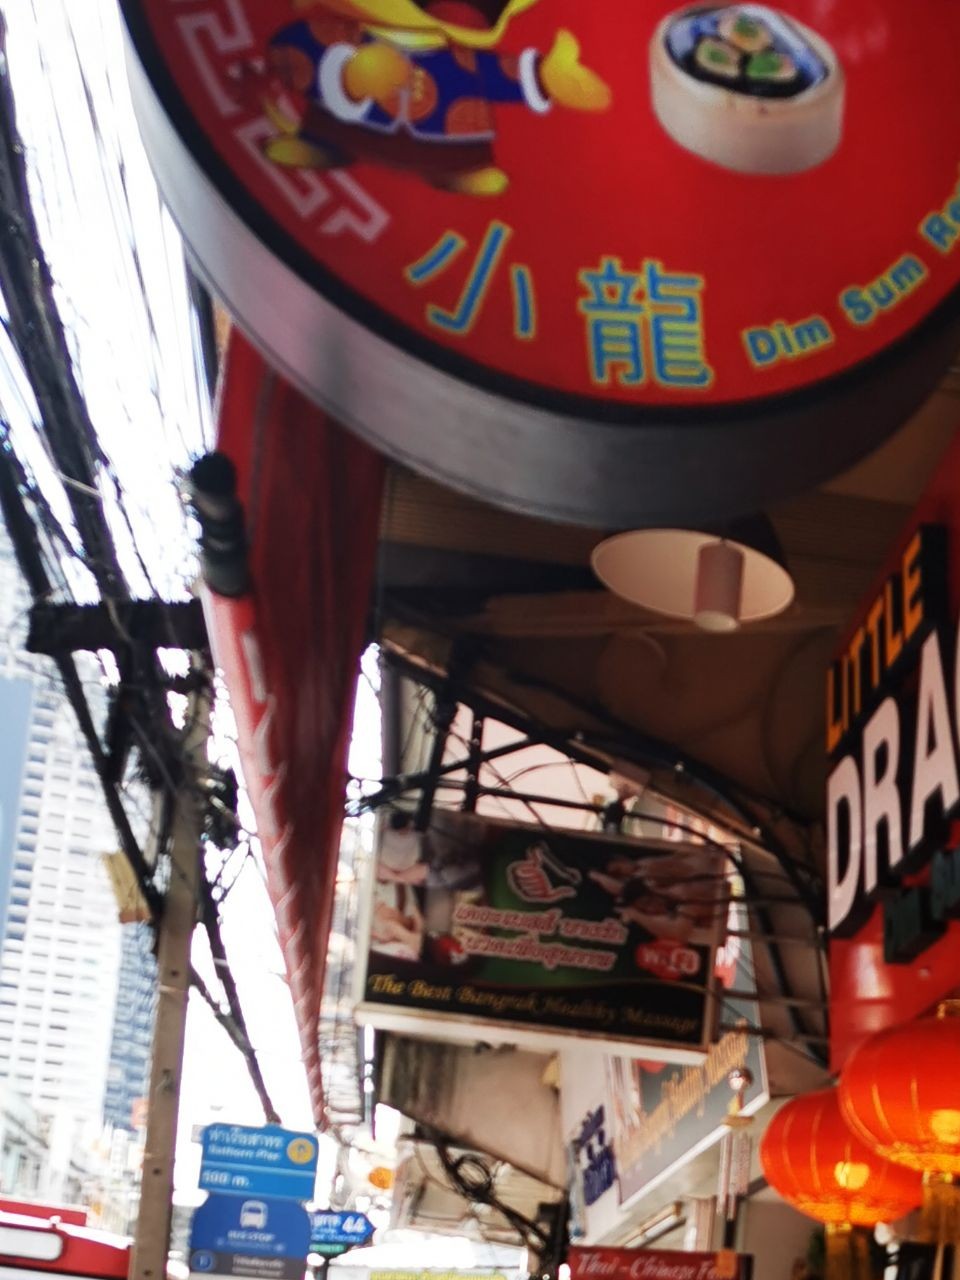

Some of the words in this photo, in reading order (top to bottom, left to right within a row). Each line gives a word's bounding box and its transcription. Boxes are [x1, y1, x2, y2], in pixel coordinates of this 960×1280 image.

[742, 314, 834, 369] Dim
[838, 252, 930, 325] Sum
[825, 531, 924, 754] LITTLE
[369, 973, 405, 995] The
[342, 1215, 366, 1233] 44
